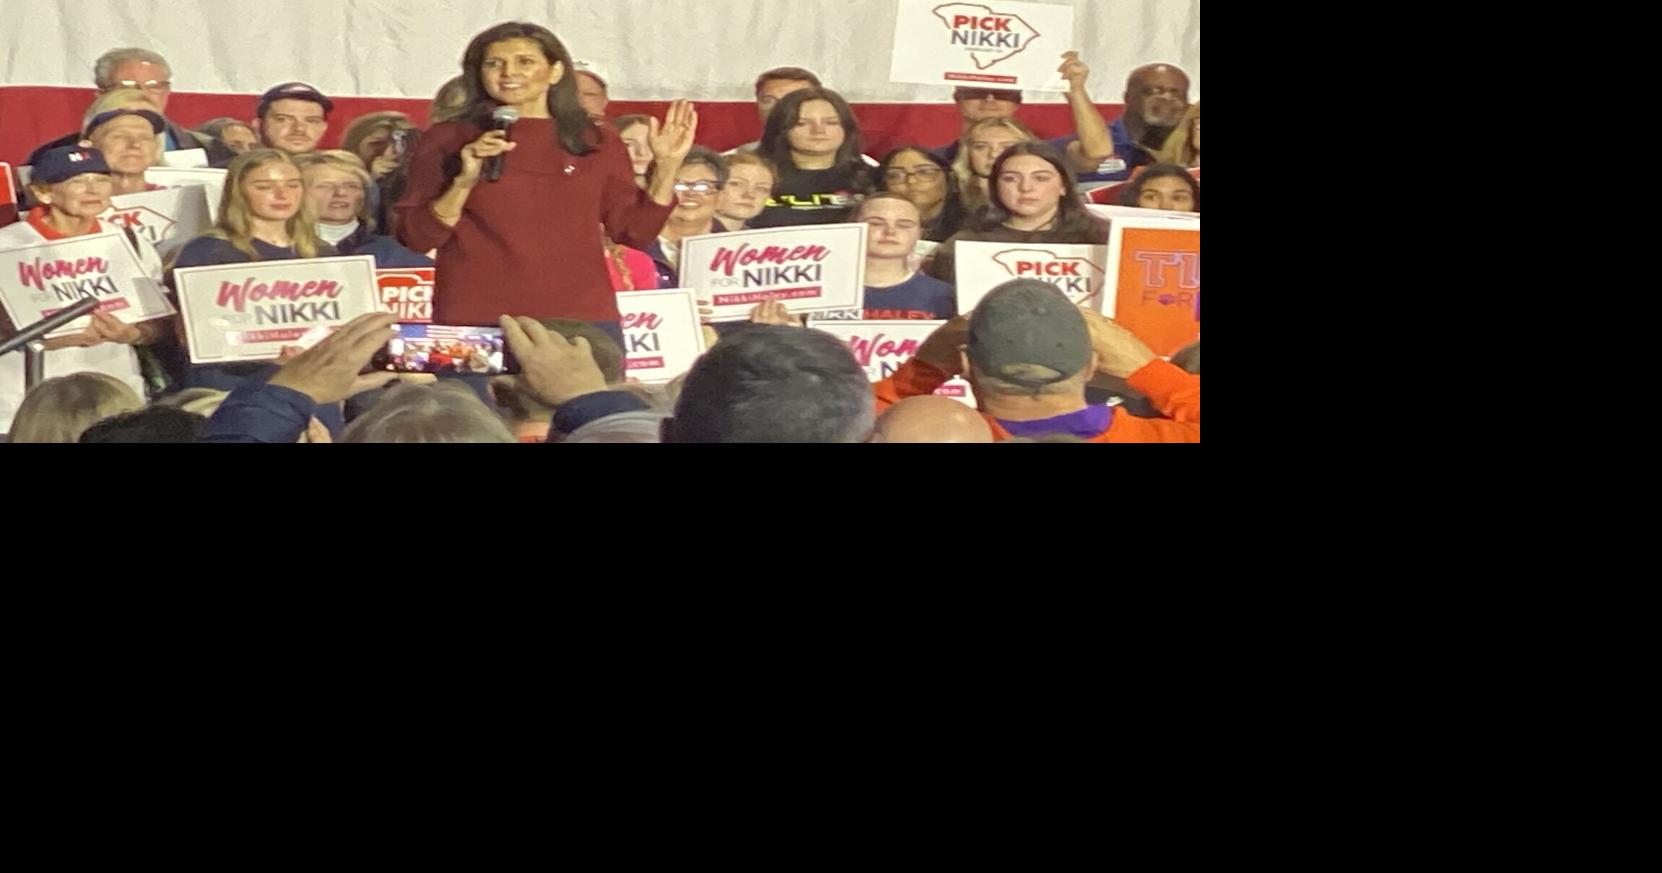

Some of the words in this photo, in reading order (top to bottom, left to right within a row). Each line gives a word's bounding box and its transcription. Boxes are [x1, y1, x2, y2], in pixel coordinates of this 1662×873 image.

[953, 15, 1012, 32] PICK
[951, 30, 1020, 48] NIKKI
[708, 243, 831, 276] Women
[1016, 261, 1082, 277] PICK
[17, 257, 109, 291] Women
[743, 264, 822, 288] NIKKI
[52, 275, 120, 302] NIKKI
[216, 276, 343, 313] Women
[255, 301, 340, 325] NIKKI
